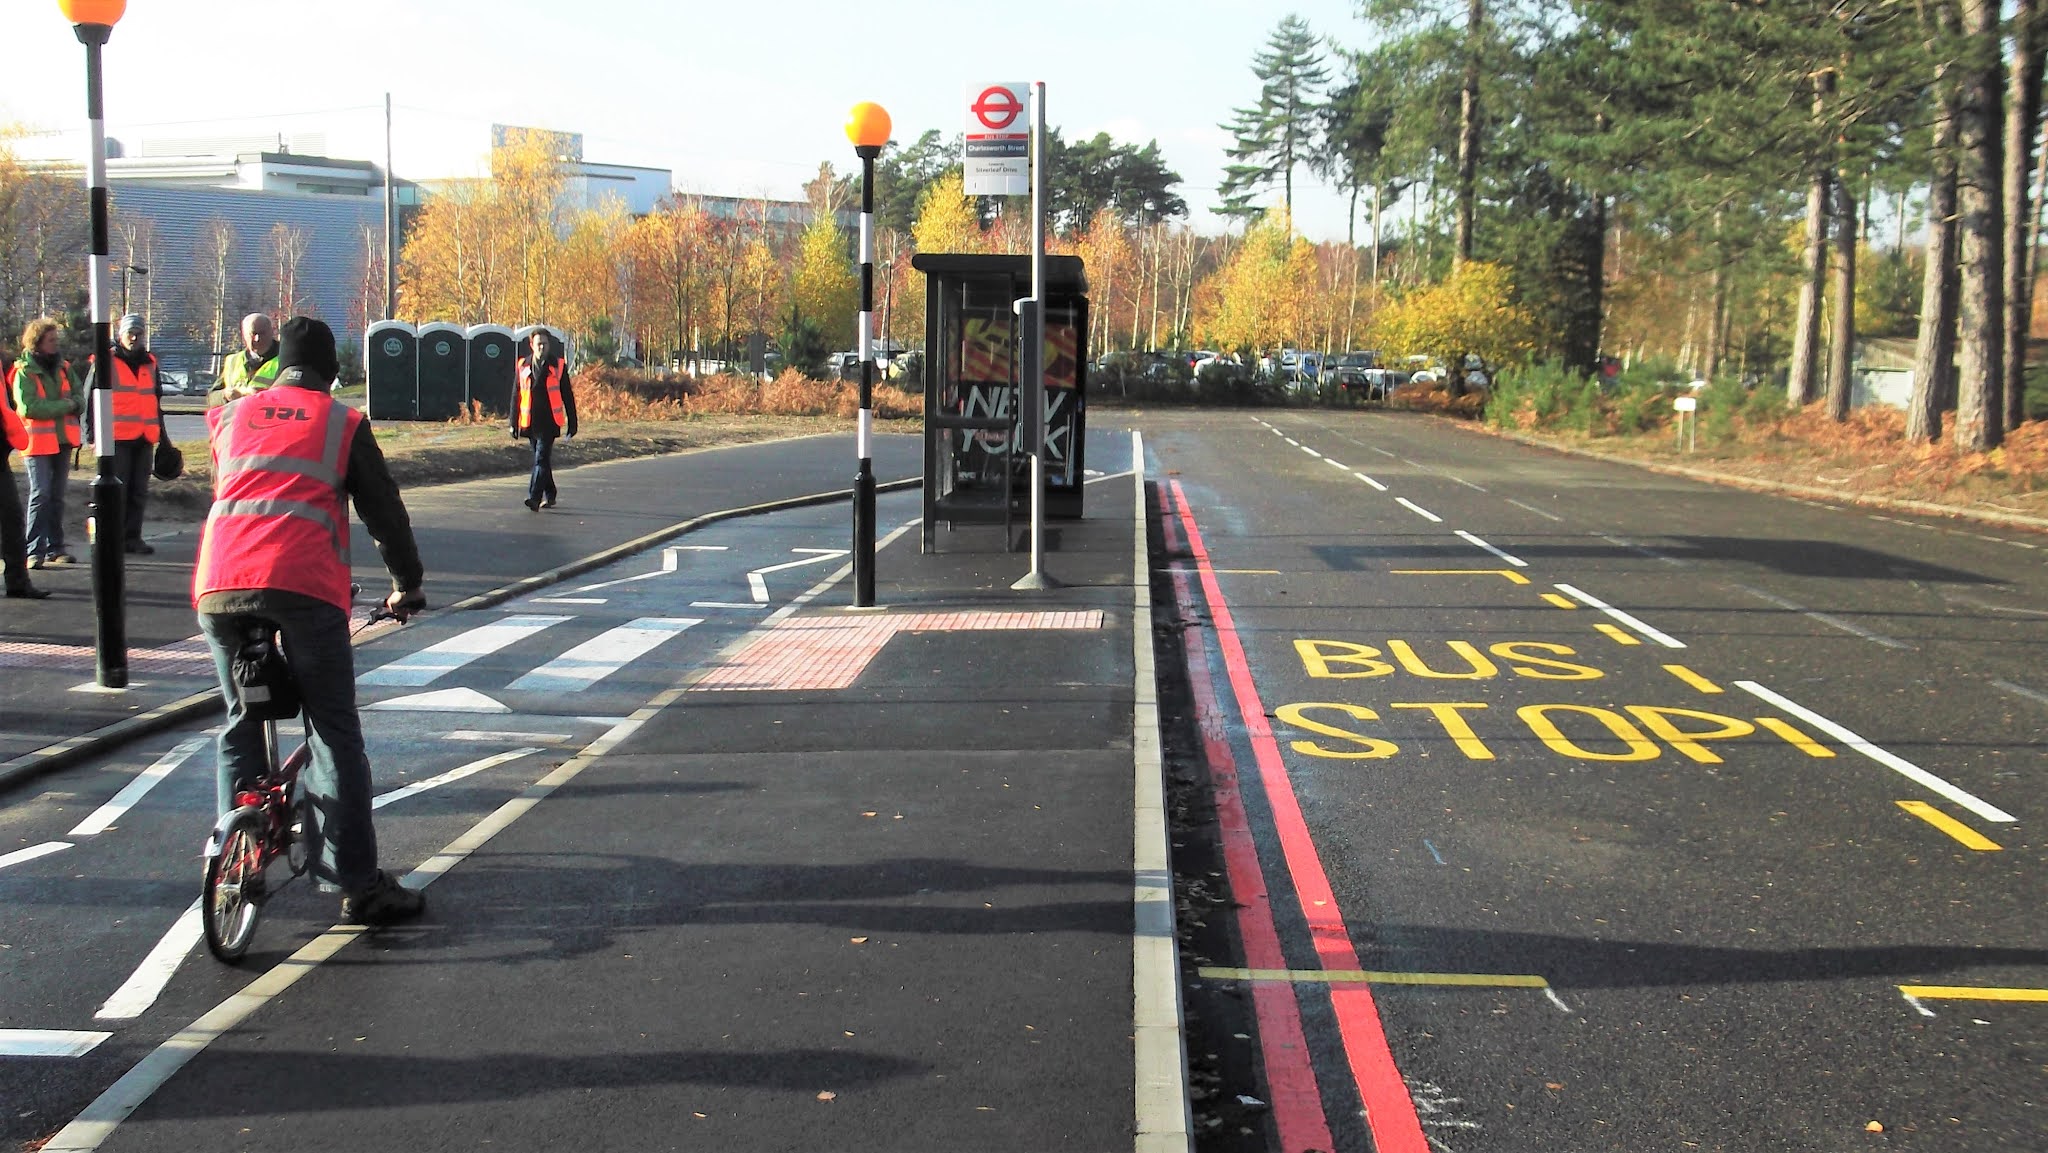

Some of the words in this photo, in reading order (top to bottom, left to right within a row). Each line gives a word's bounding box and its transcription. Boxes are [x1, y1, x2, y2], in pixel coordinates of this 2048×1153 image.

[1007, 144, 1025, 152] Street
[259, 406, 312, 421] TRL
[1293, 639, 1604, 680] BUS
[1274, 702, 1756, 764] STOP
